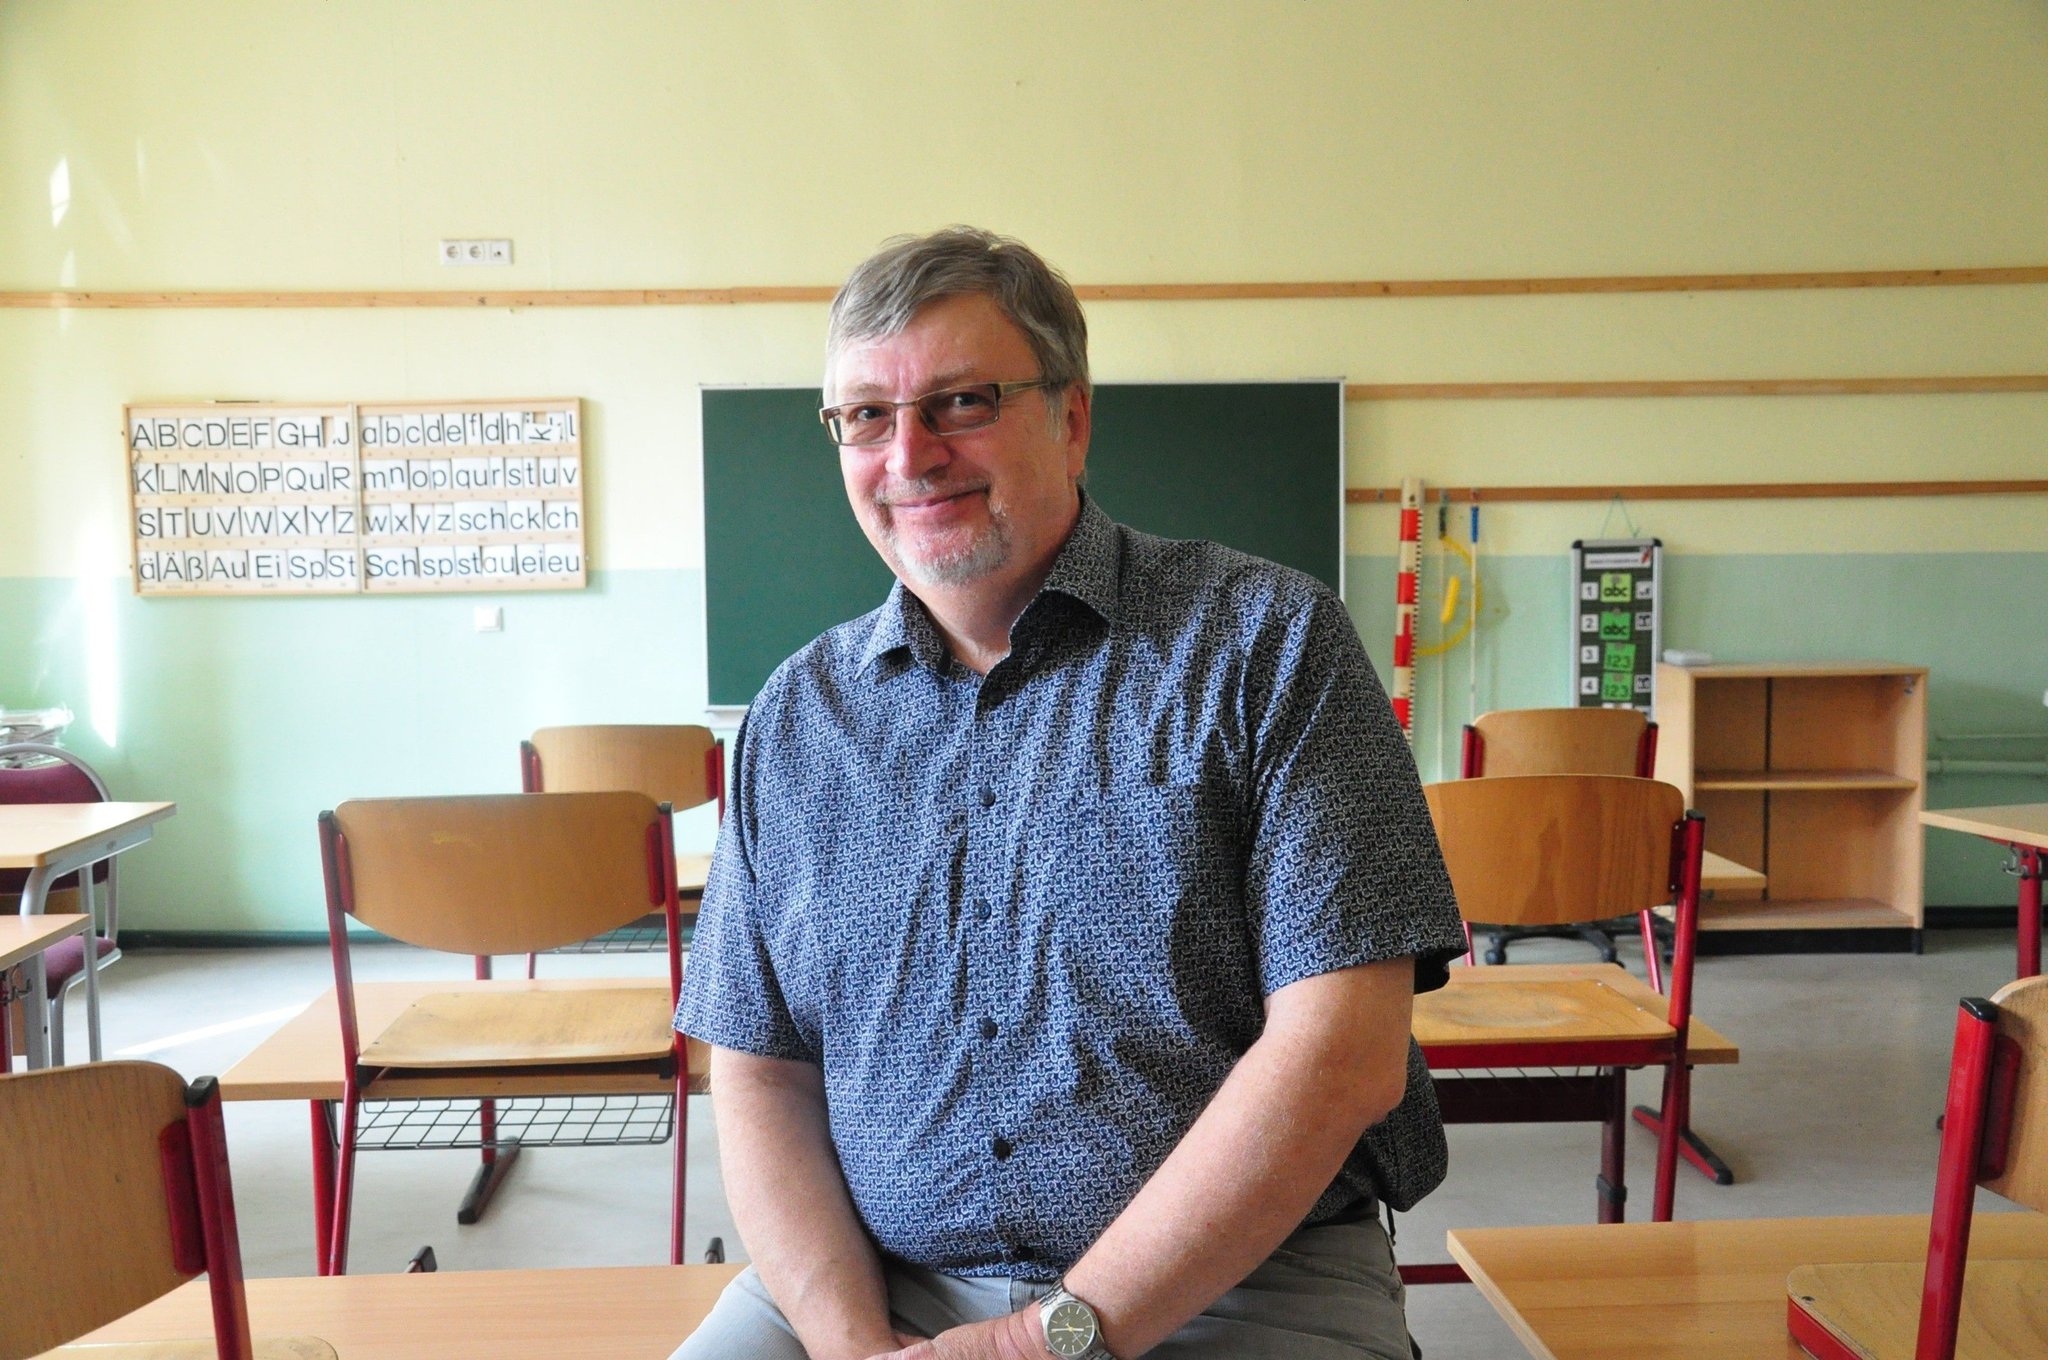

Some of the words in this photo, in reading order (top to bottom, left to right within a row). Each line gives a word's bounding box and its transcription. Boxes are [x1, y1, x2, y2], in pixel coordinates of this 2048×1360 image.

[133, 424, 153, 447] A
[158, 424, 177, 447] B
[182, 423, 202, 447] C
[206, 423, 226, 446] D
[232, 423, 249, 446] E
[254, 423, 270, 446] F
[278, 422, 299, 446] G
[302, 424, 321, 448] H
[362, 426, 377, 445] a
[386, 420, 401, 444] b
[406, 425, 421, 444] c
[427, 418, 442, 443] d
[447, 424, 462, 443] e
[506, 418, 520, 441] h
[134, 469, 155, 492] K
[161, 469, 176, 492] L
[182, 469, 204, 492] M
[211, 471, 230, 494] N
[236, 470, 257, 494] O
[263, 468, 280, 491] P
[286, 467, 325, 492] Qu
[332, 466, 350, 490] R
[362, 471, 387, 489] m
[390, 466, 405, 484] n
[412, 470, 428, 488] o
[492, 468, 501, 486] r
[508, 468, 522, 486] s
[527, 462, 535, 485] t
[543, 467, 557, 485] u
[563, 467, 577, 484] v
[138, 512, 156, 536] S
[165, 512, 182, 535] T
[192, 512, 210, 536] U
[216, 511, 236, 535] V
[244, 511, 272, 534] W
[282, 511, 301, 534] X
[310, 511, 330, 534] Y
[337, 511, 354, 534] Z
[163, 551, 183, 580] Ä
[210, 556, 247, 579] Au
[256, 555, 281, 579] Ei
[329, 554, 355, 578] St
[366, 553, 418, 577] Sch
[1603, 582, 1628, 598] abc
[1603, 622, 1628, 636] abc
[1606, 654, 1631, 669] 123
[1605, 684, 1629, 698] 123
